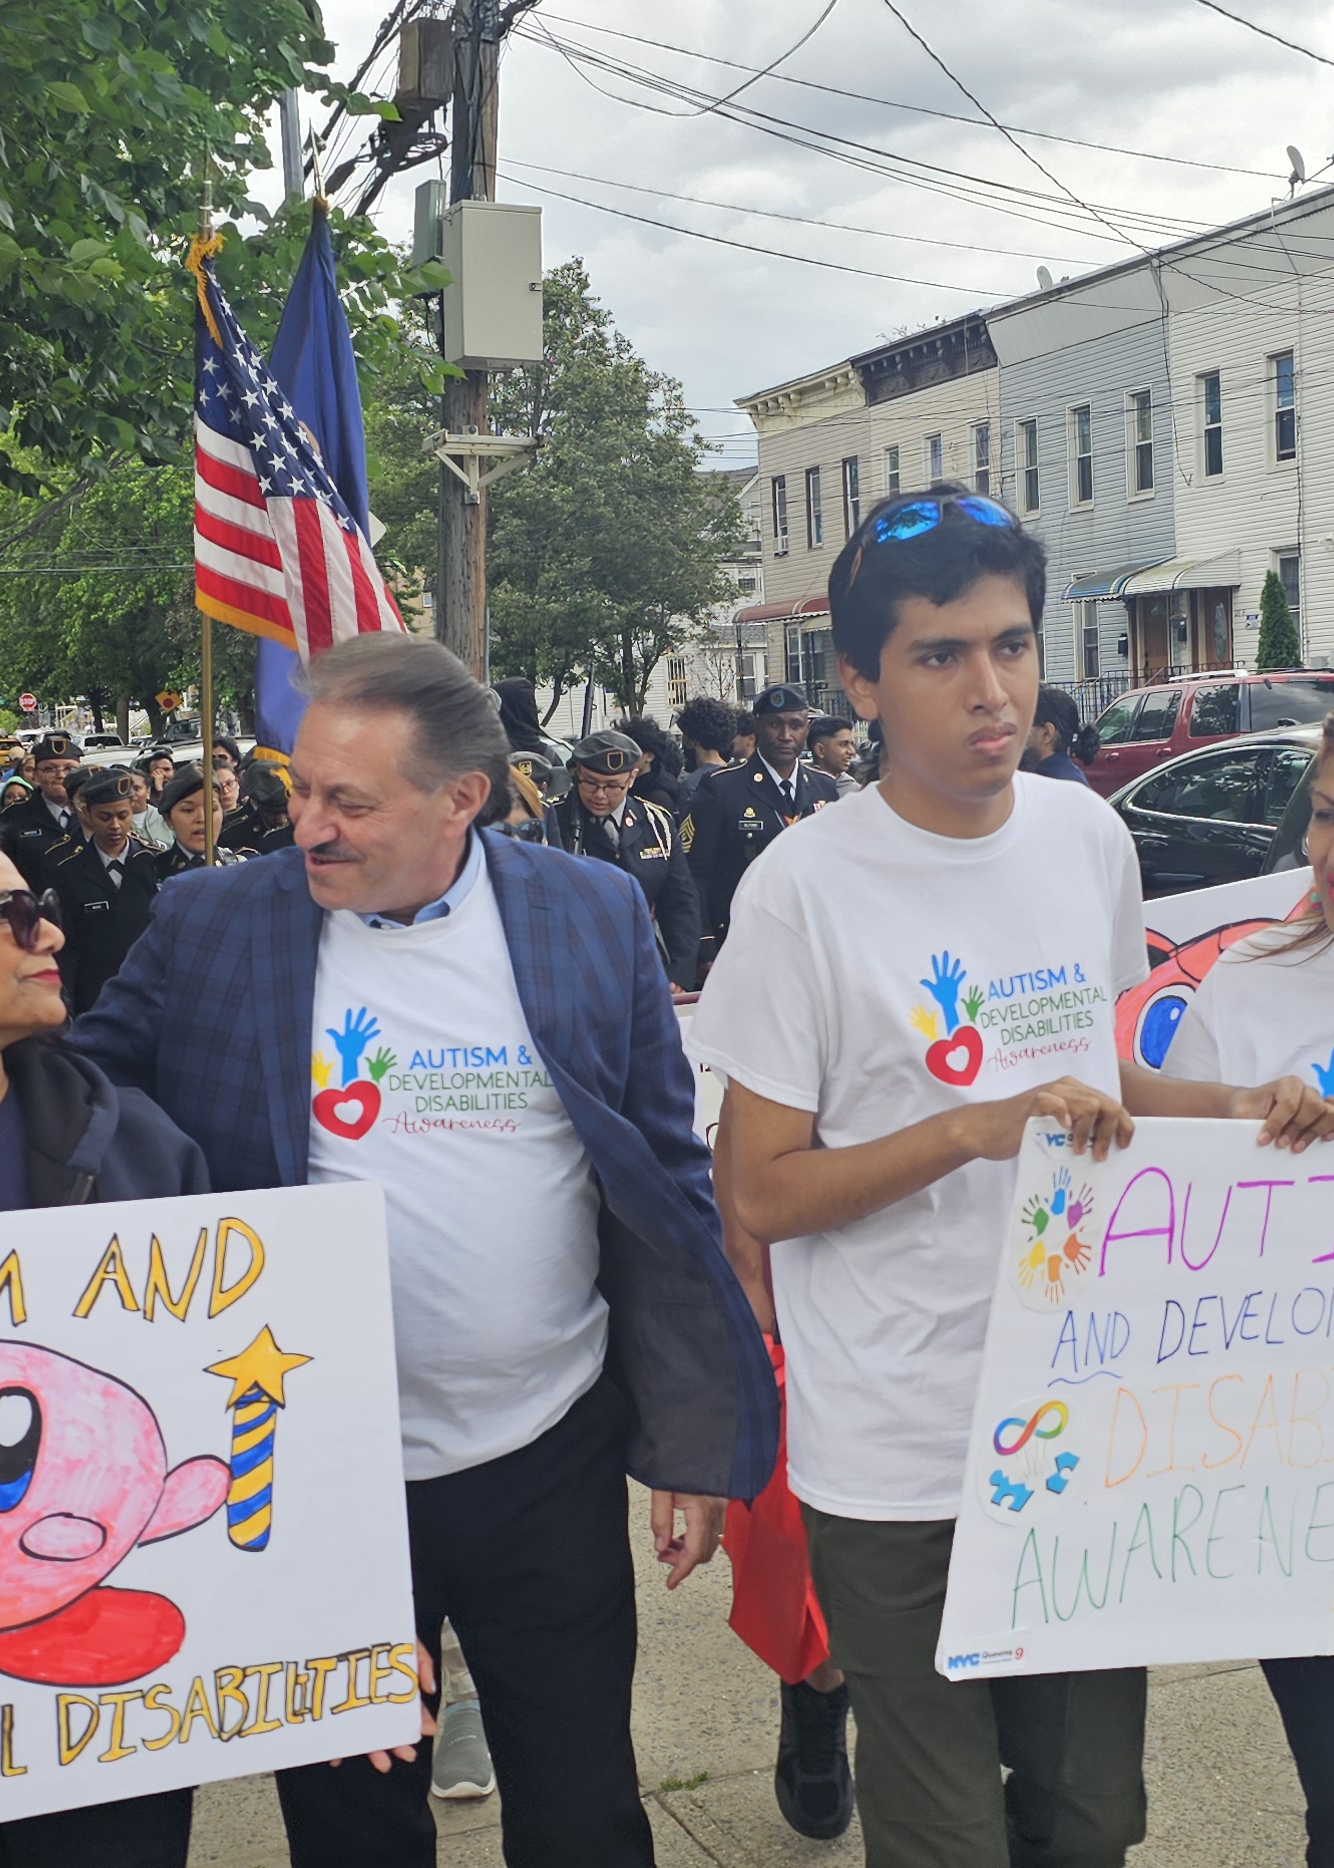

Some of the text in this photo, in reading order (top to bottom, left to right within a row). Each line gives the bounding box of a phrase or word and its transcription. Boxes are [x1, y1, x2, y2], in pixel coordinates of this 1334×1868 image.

[988, 963, 1086, 1001] AUTISM &
[980, 985, 1107, 1029] DEVELOPMENTAL
[1000, 1010, 1094, 1045] DISABILITIES
[409, 1045, 533, 1070] AUTISM &
[986, 1037, 1092, 1072] Awareness
[388, 1070, 554, 1091] DEVELOPMENTAL
[415, 1092, 528, 1112] DISABILITIES
[382, 1111, 522, 1134] Awareness
[1040, 1132, 1066, 1147] YC
[72, 1216, 266, 1323] AND
[1050, 1309, 1131, 1370] AND
[948, 1653, 980, 1669] NYC
[1014, 1647, 1024, 1660] 9
[56, 1642, 419, 1766] DISABILITIES
